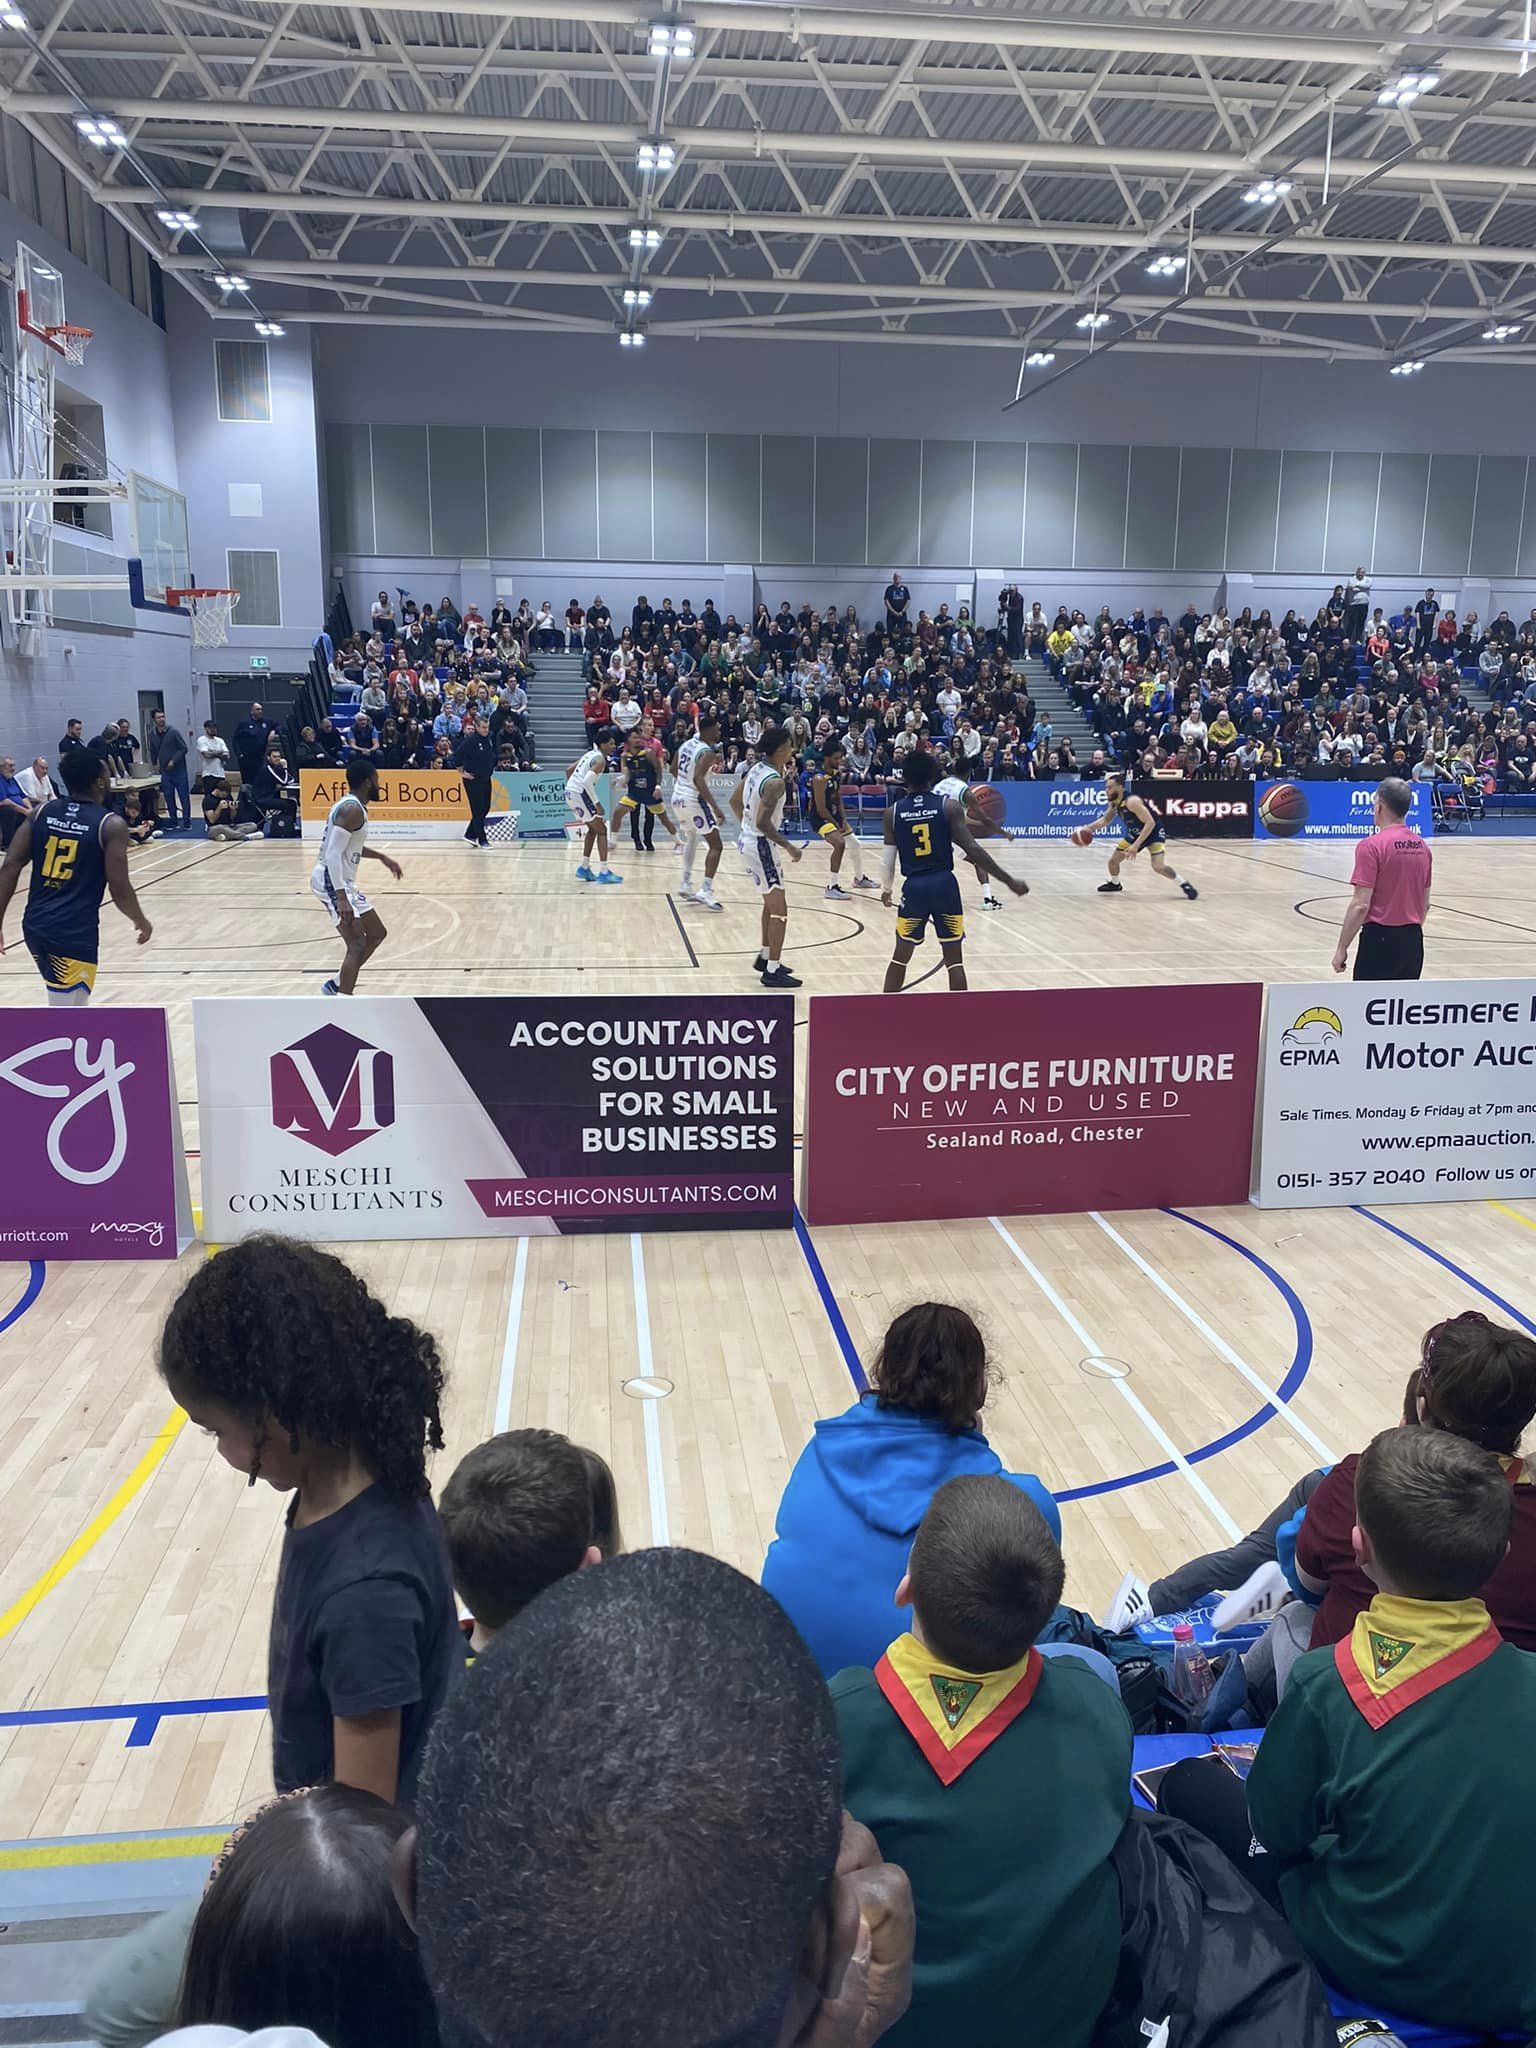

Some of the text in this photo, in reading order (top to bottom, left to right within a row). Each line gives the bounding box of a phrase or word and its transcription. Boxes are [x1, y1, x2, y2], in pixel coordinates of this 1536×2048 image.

[312, 781, 462, 803] Affd Bond
[521, 792, 531, 803] in
[533, 793, 552, 803] the
[528, 783, 546, 792] We
[1050, 787, 1109, 806] molte
[1062, 807, 1077, 816] the
[1078, 807, 1098, 816] real
[1166, 798, 1248, 818] Kappa
[912, 823, 932, 857] 3
[41, 835, 79, 880] 12
[1365, 998, 1519, 1026] Ellesmere
[509, 1019, 778, 1047] ACCOUNTANCY
[1279, 1049, 1340, 1066] EPMA
[1365, 1040, 1536, 1070] Motor Auc
[591, 1055, 778, 1082] SOLUTIONS
[834, 1053, 1235, 1097] CITY OFFICE FURNITURE
[600, 1090, 778, 1117] FOR SMALL
[892, 1090, 1180, 1120] NEW AND USED
[1280, 1109, 1309, 1121] Sale
[1356, 1107, 1406, 1120] Monday
[1410, 1106, 1420, 1117] &
[1424, 1104, 1464, 1118] Friday
[1468, 1105, 1482, 1115] at
[1486, 1103, 1513, 1117] 7pm
[582, 1125, 777, 1153] BUSINESSES
[926, 1124, 1144, 1149] Sealand Road, Chester
[279, 1166, 393, 1187] MESCHI
[1277, 1172, 1322, 1188] 0151-
[1328, 1171, 1367, 1186] 357
[1373, 1168, 1425, 1184] 2040
[1436, 1166, 1490, 1182] Follow
[1495, 1168, 1514, 1180] us
[228, 1190, 444, 1212] CONSULTANTS
[495, 1184, 777, 1207] MESCHICONSULTANTS.COM
[90, 1221, 165, 1247] moxy
